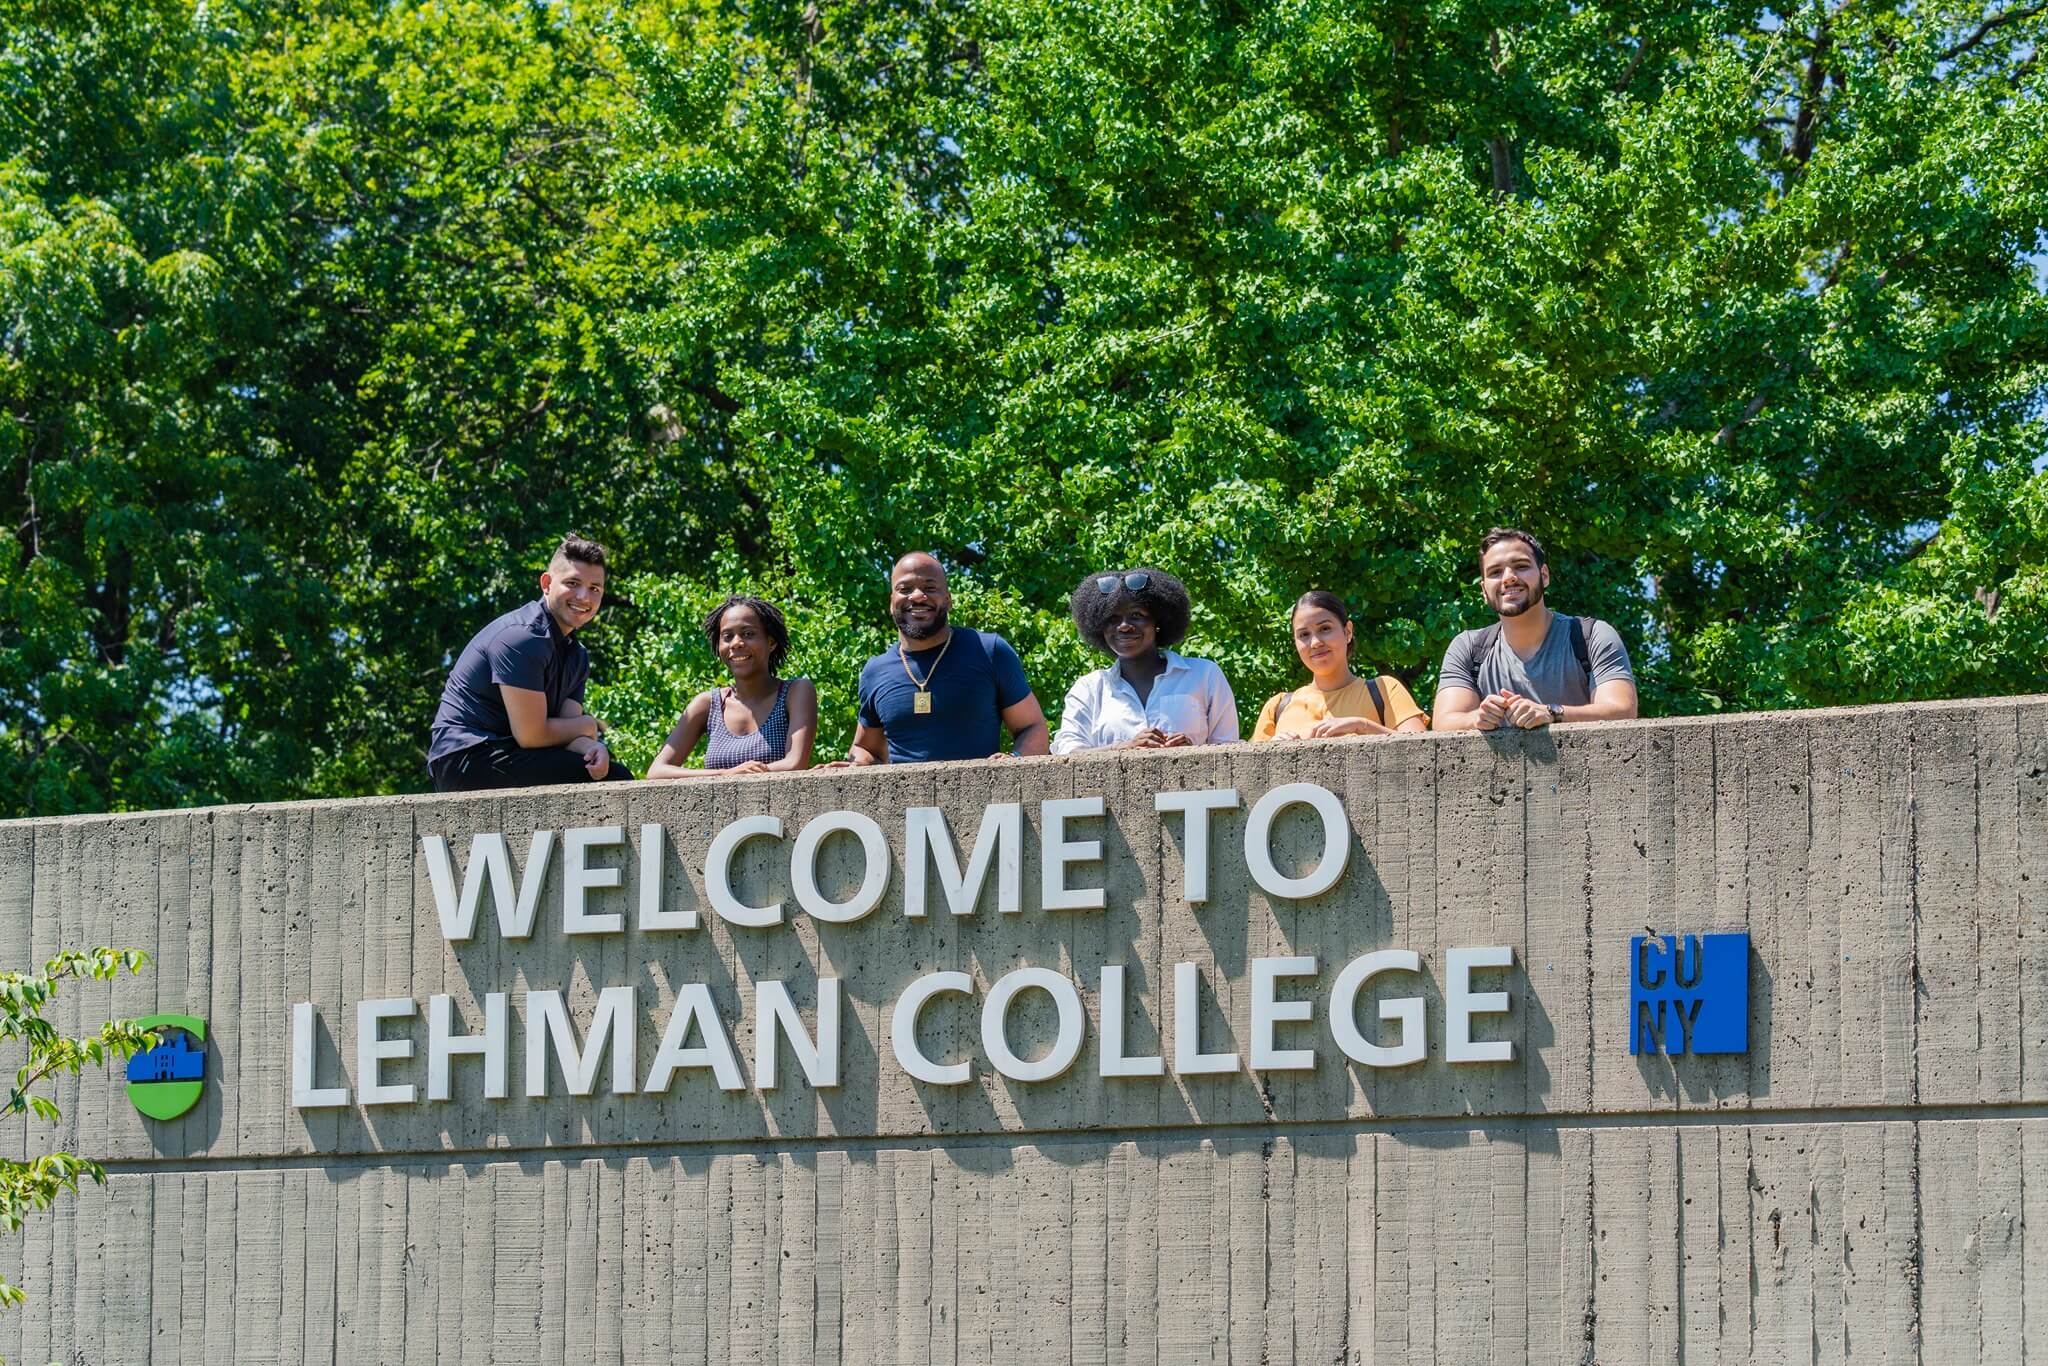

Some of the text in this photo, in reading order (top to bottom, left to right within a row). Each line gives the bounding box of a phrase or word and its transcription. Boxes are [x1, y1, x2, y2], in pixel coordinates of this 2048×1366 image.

[422, 782, 1352, 941] WELCOME TO
[1638, 936, 1703, 990] CU
[292, 946, 1516, 1108] LEHMAN COLLEGE
[1638, 999, 1703, 1055] NY
